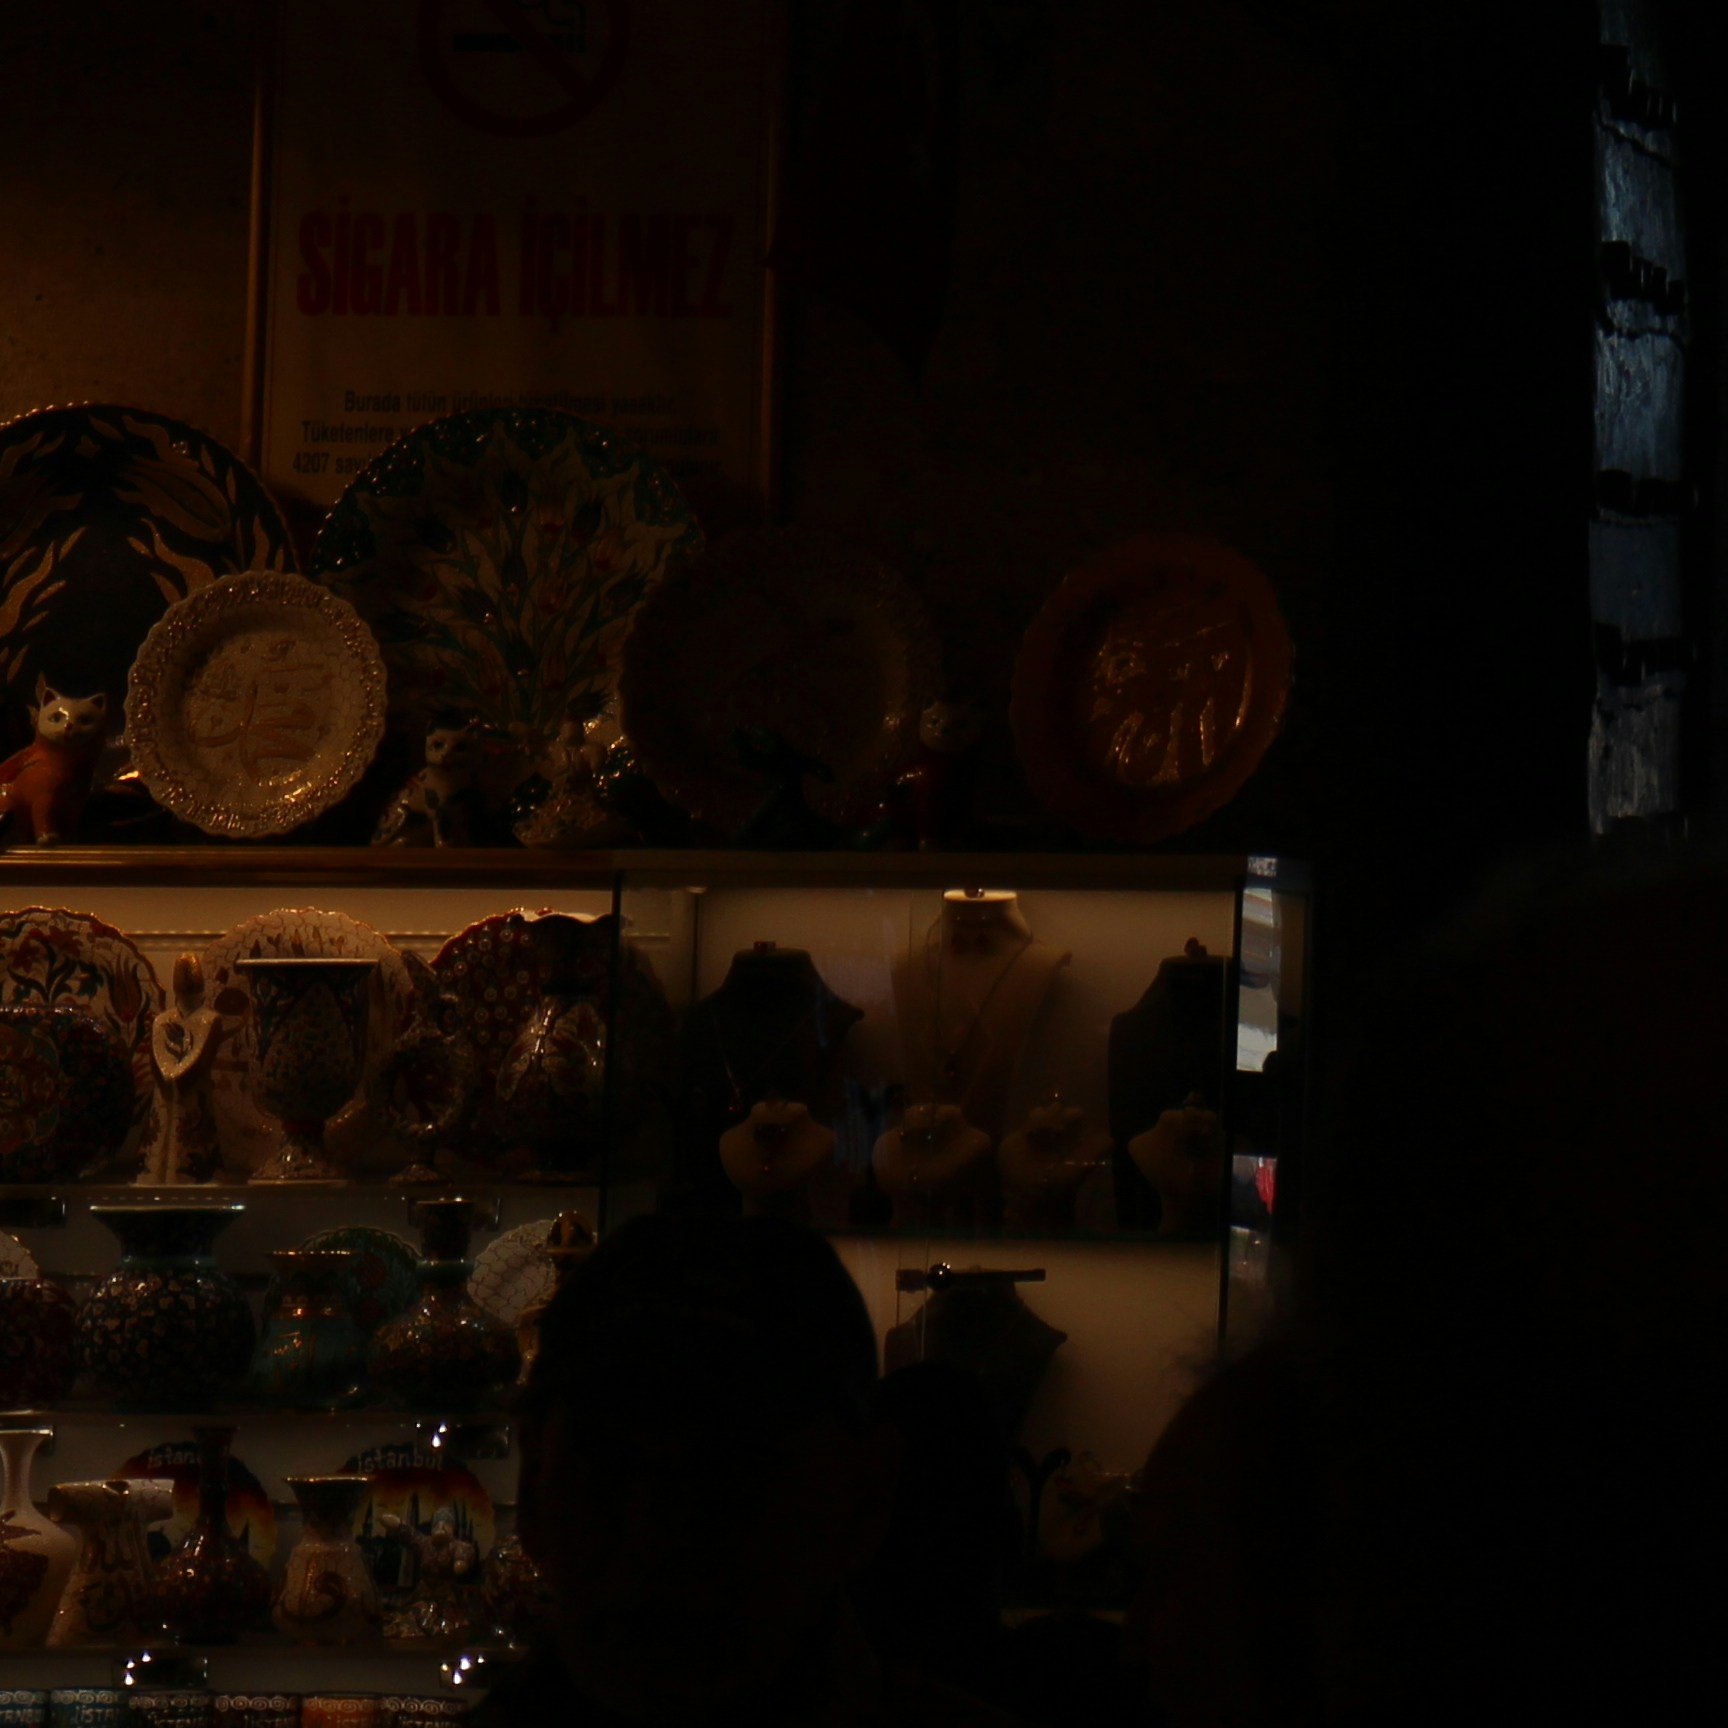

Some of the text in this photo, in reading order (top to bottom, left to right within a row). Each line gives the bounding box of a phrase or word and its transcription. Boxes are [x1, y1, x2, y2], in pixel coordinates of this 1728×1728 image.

[298, 195, 736, 334] SİGARA İÇİLMEZ
[344, 389, 400, 413] Burada
[292, 452, 329, 474] 4207
